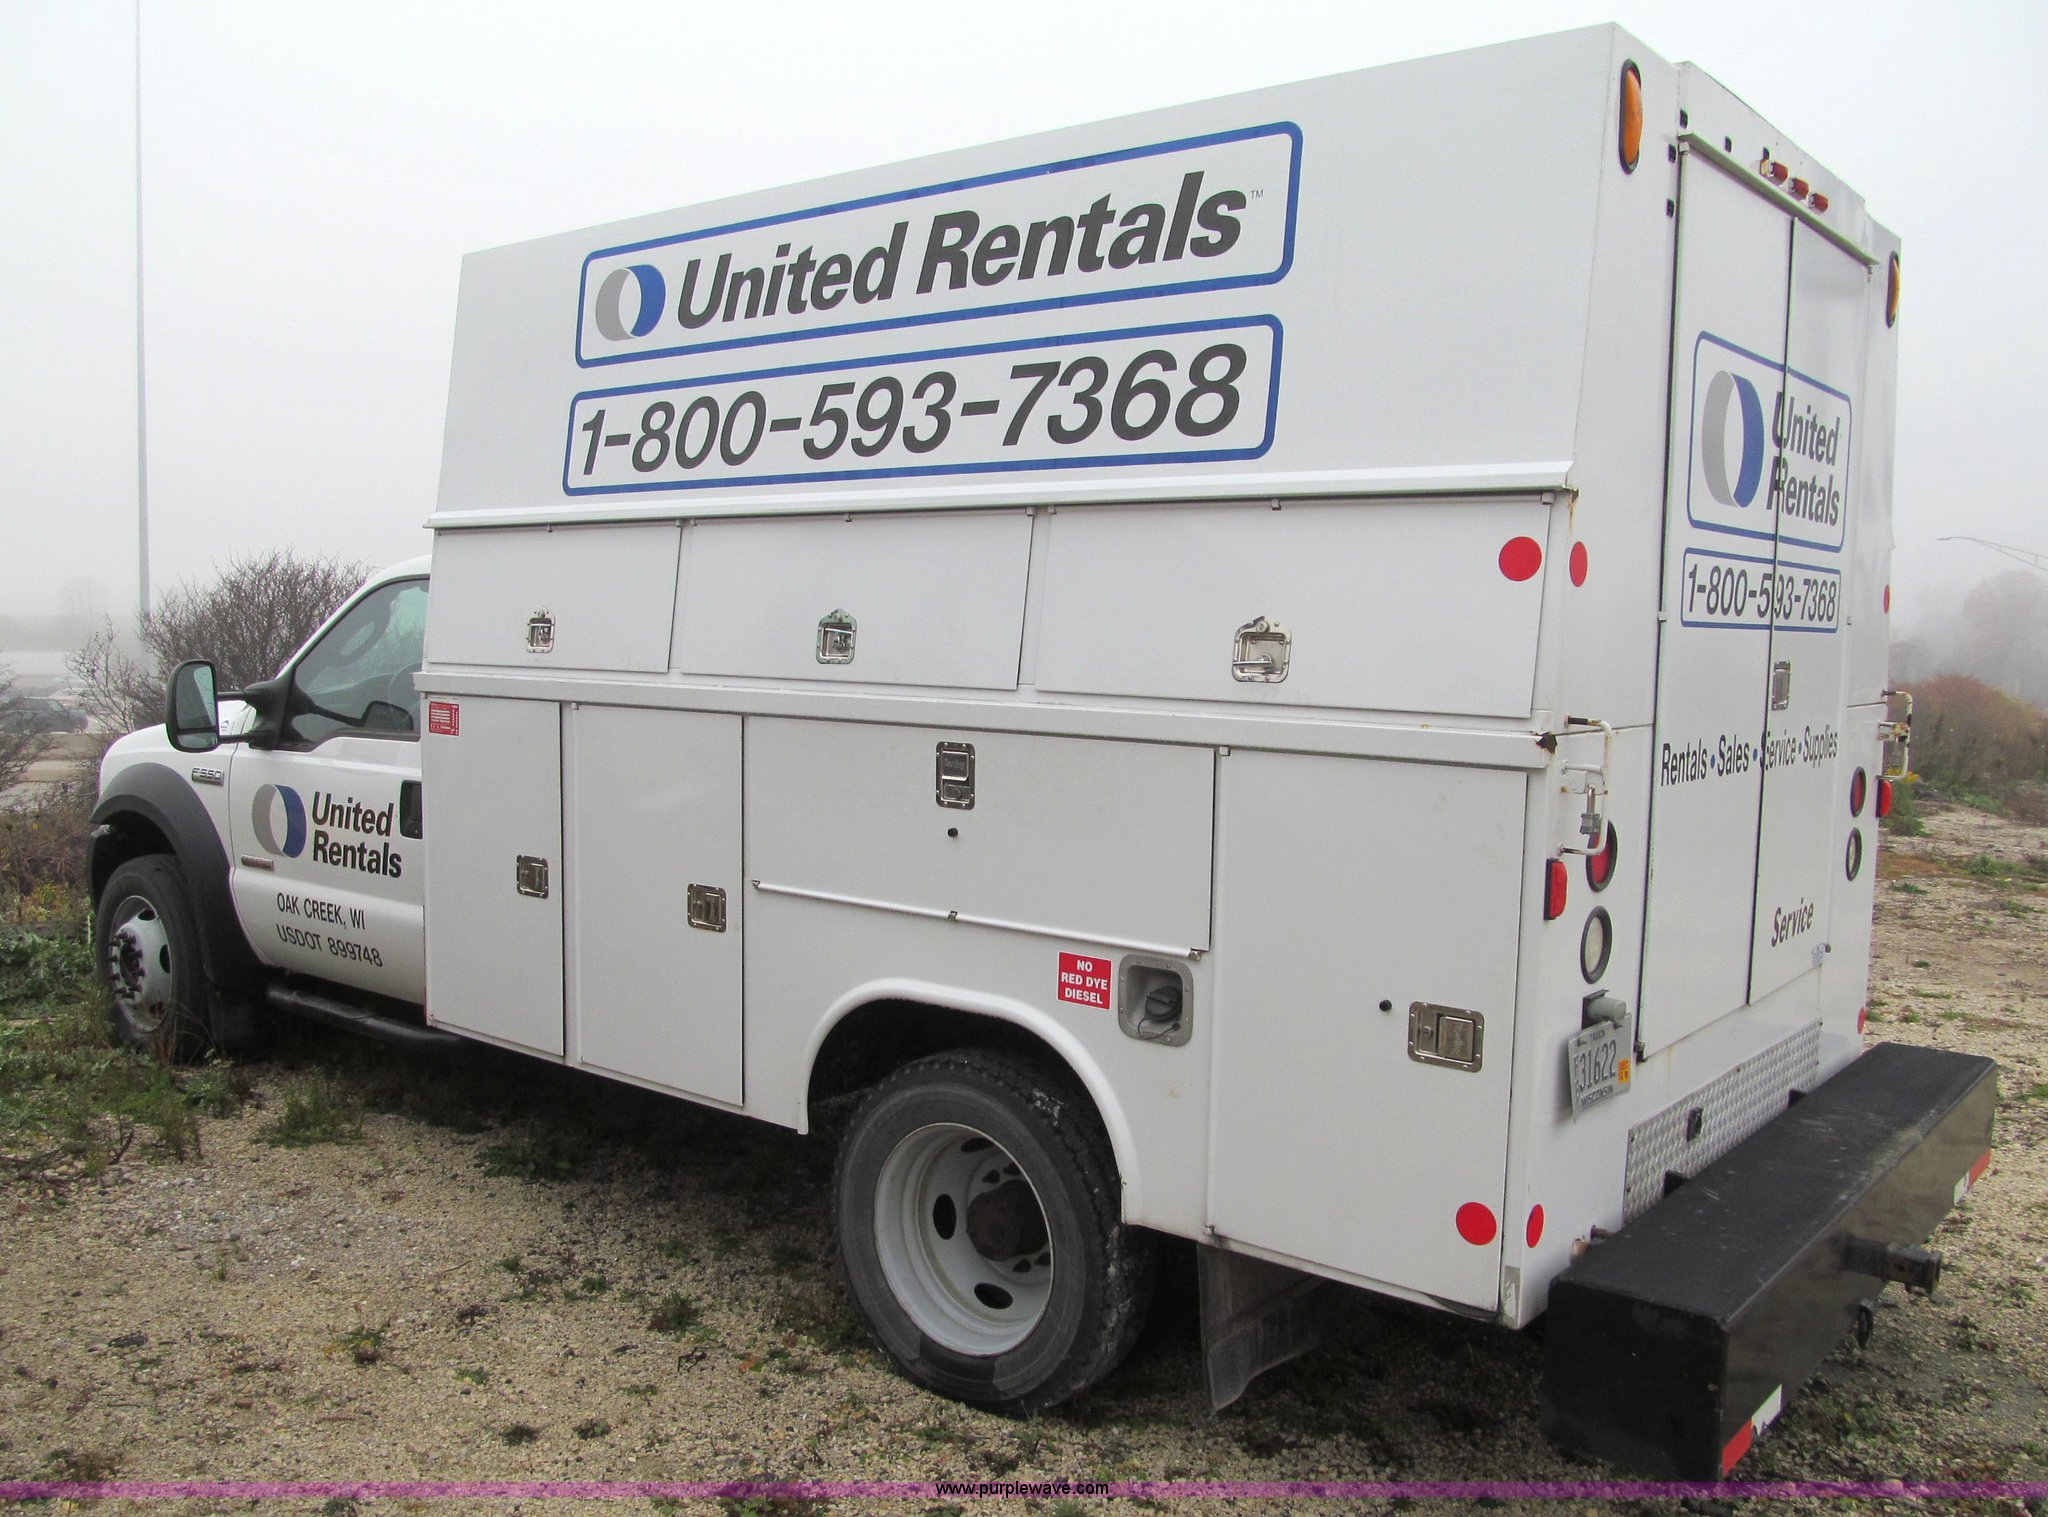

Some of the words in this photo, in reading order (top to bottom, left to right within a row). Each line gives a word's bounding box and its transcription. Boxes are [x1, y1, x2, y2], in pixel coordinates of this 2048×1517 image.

[677, 220, 909, 330] United
[916, 170, 1248, 294] Rentals
[582, 343, 1248, 475] 1-800-593-7368
[1771, 391, 1840, 466] United
[1766, 455, 1840, 527] Rentals
[1688, 563, 1837, 622] 1-800-593-7368
[1661, 738, 1707, 786] Rentals
[1717, 734, 1749, 777] Sales
[1803, 724, 1838, 768] Supplies
[312, 791, 394, 837] United
[312, 830, 402, 878] Rentals
[276, 892, 300, 916] OAK
[303, 897, 347, 930] CREEK,
[350, 908, 366, 930] WI
[1771, 897, 1814, 948] Service
[276, 923, 323, 951] USDOT
[327, 936, 383, 967] 899748
[1076, 959, 1093, 972] NO
[1061, 972, 1083, 985] RED
[1086, 976, 1108, 990] DYE
[1065, 987, 1103, 1004] DIESEL
